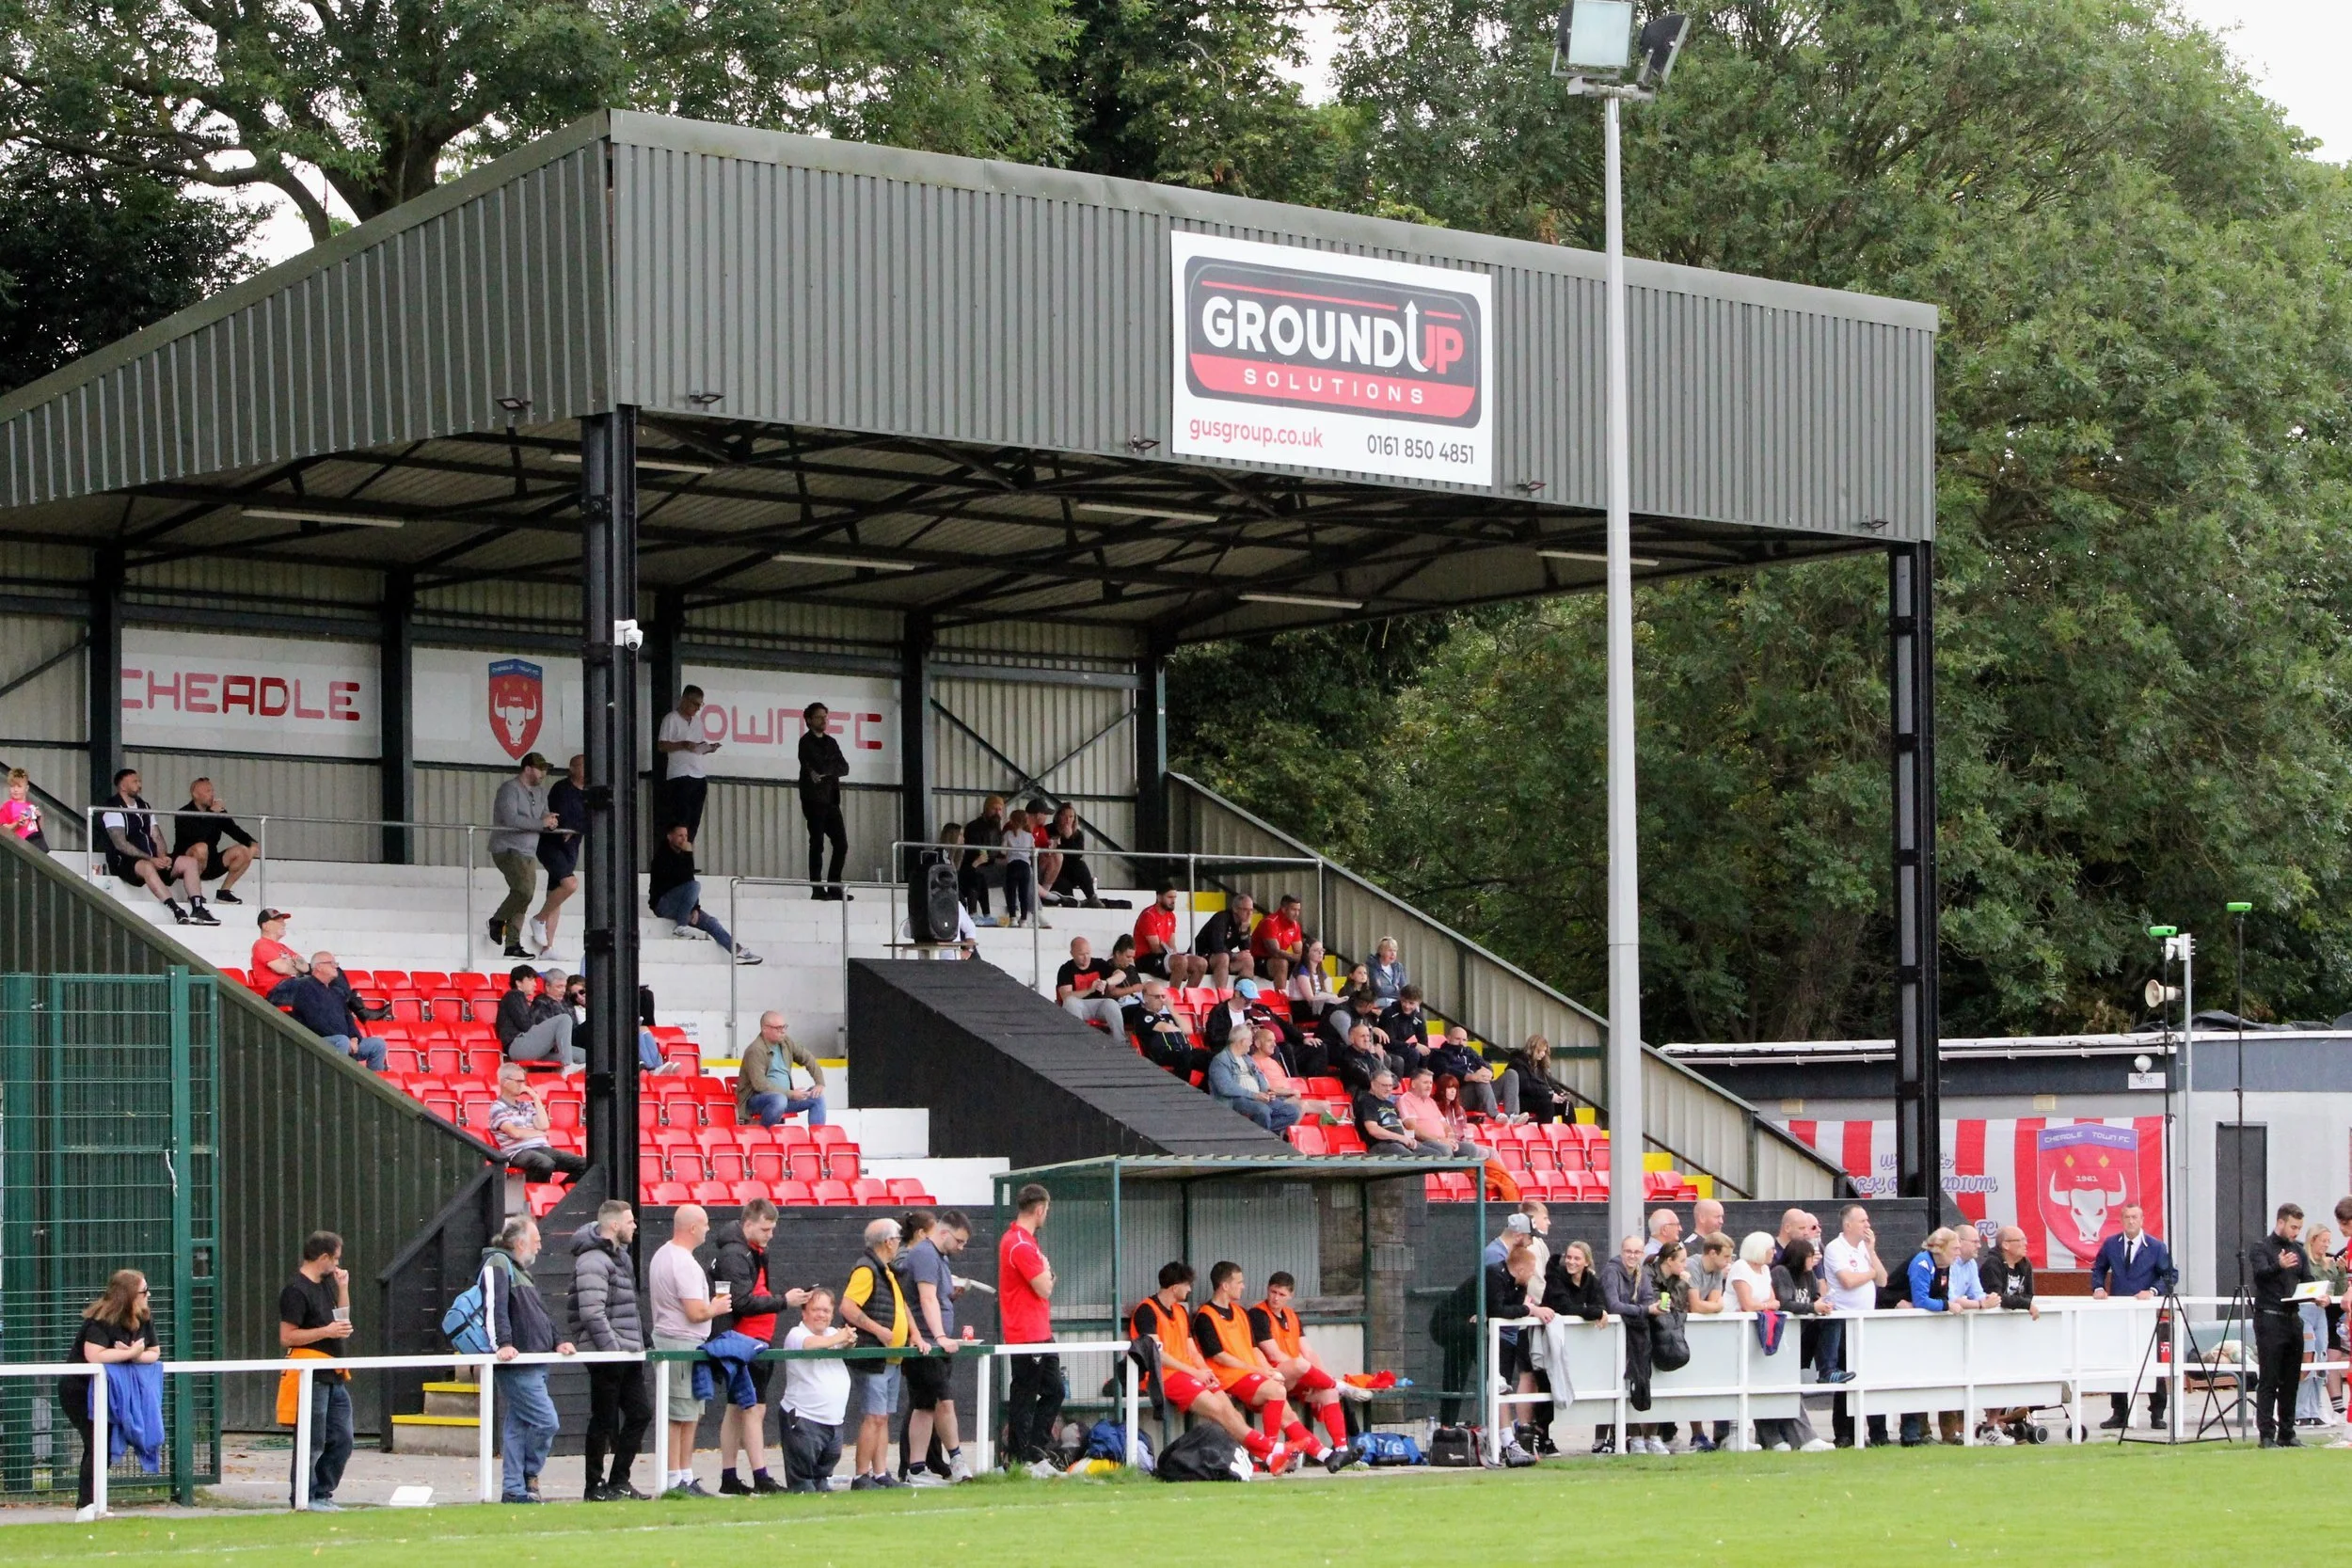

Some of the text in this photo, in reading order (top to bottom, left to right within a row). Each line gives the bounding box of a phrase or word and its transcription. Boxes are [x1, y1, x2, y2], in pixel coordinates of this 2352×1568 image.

[1244, 368, 1423, 404] SOLUTIONS
[1189, 417, 1324, 449] gusgroup.co.uk
[1367, 434, 1475, 465] 0161 850 4851
[120, 668, 361, 721] CHEADLE
[701, 704, 805, 745] OWN
[2043, 1131, 2131, 1144] CHEADLE TOWN FC
[1849, 1176, 1884, 1194] RK
[1941, 1176, 1997, 1193] ADIUM
